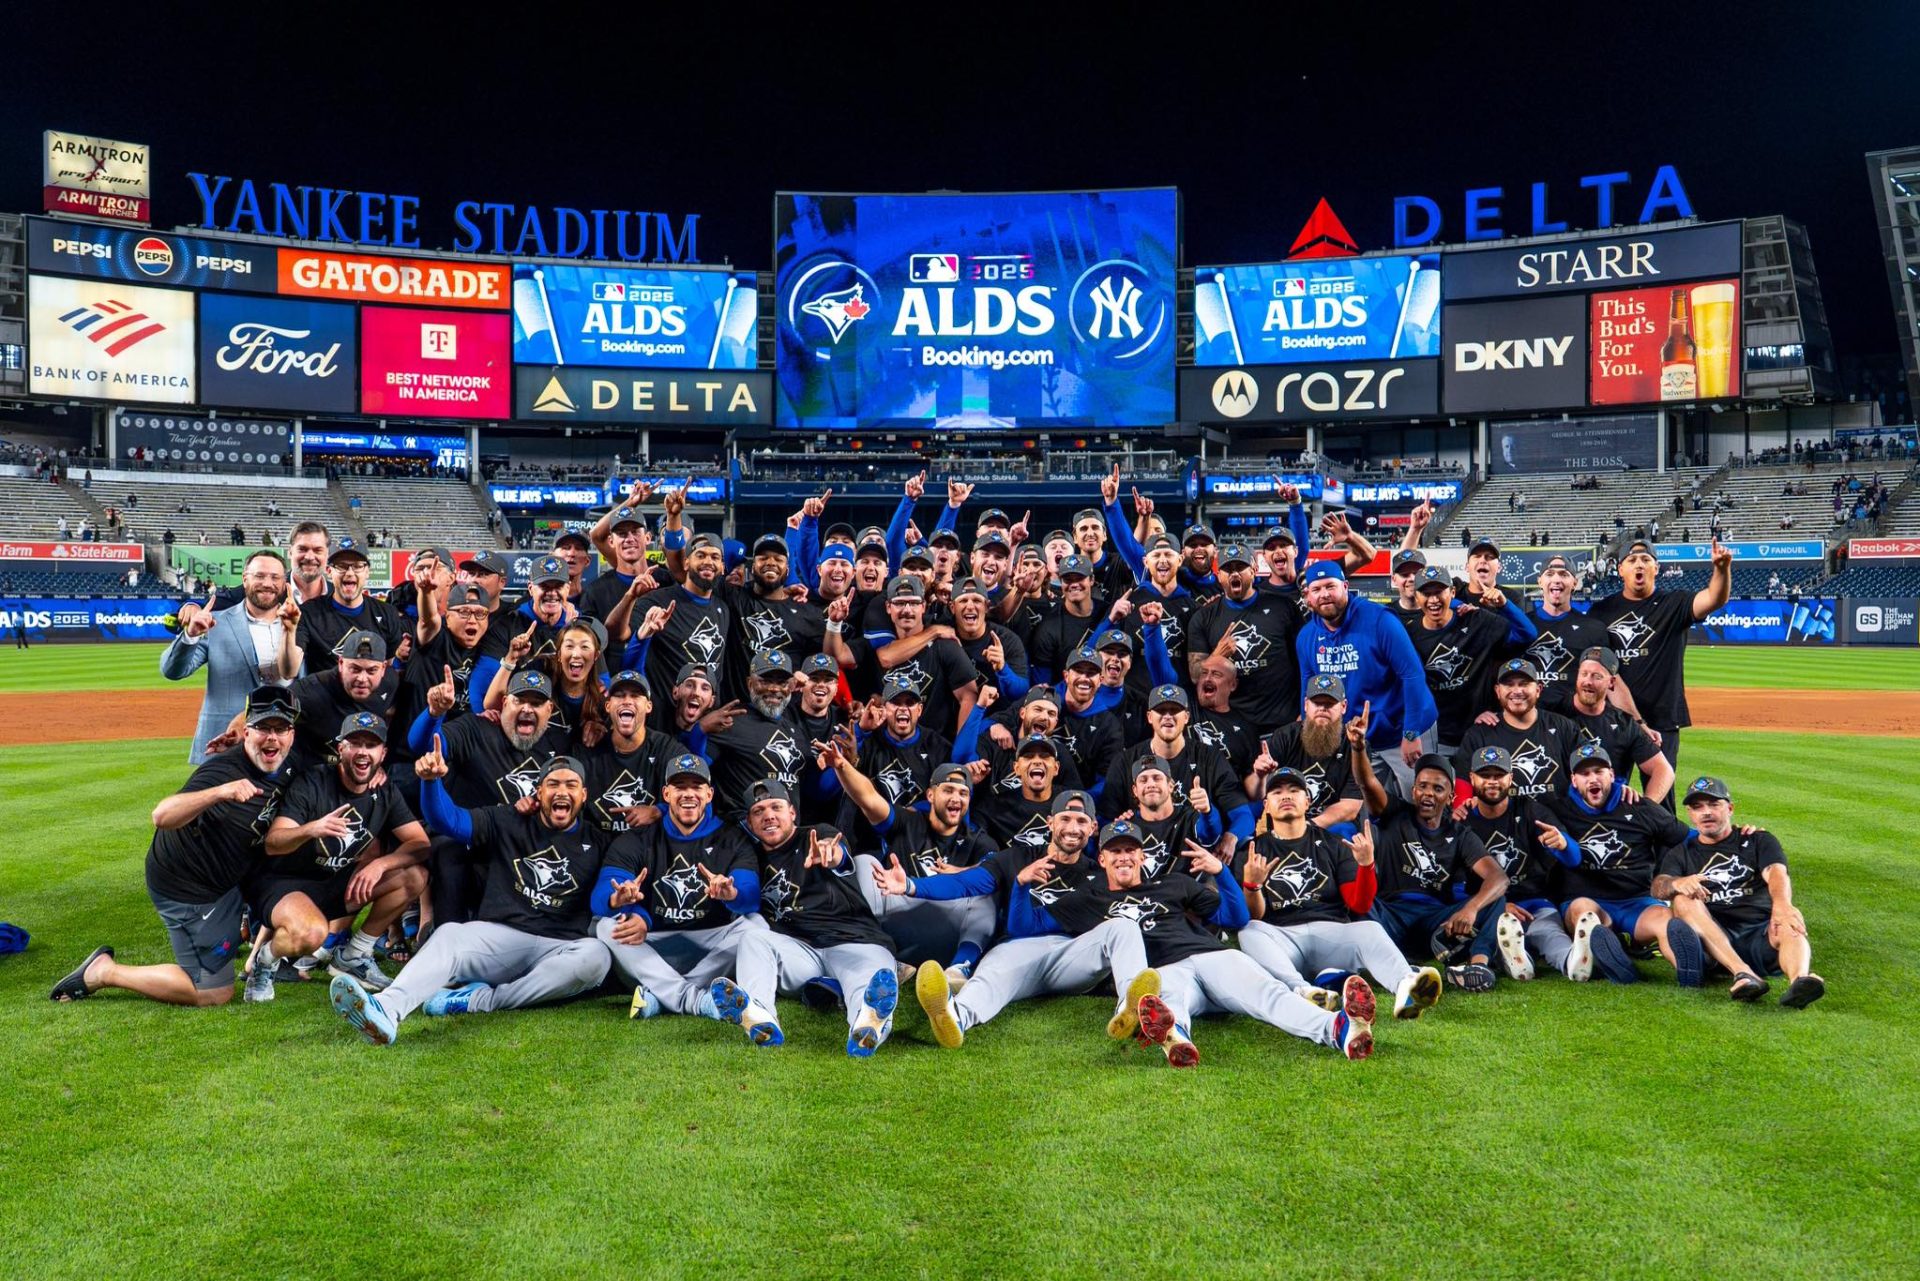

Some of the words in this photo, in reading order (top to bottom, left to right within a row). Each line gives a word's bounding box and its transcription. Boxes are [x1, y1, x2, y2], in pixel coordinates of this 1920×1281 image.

[52, 140, 144, 165] ARMITRON
[57, 190, 140, 211] ARMITRON
[1393, 165, 1698, 249] DELTA
[98, 206, 138, 219] WATCHES
[186, 171, 420, 250] YANKEE
[453, 201, 701, 264] STADIUM
[53, 238, 111, 259] PEPSI
[137, 252, 171, 263] PEPSI
[197, 255, 252, 274] PEPSI
[1517, 241, 1661, 288] STARR
[292, 258, 500, 300] GATORADE
[966, 263, 1035, 280] 2025
[629, 291, 674, 302] 2025
[1309, 282, 1355, 295] 2025
[891, 285, 1057, 336] ALDS
[1262, 295, 1368, 331] ALDS
[1599, 297, 1646, 317] This
[581, 304, 684, 336] ALDS
[1600, 317, 1656, 338] Bud's
[216, 323, 341, 378] Ford
[601, 339, 685, 356] Booking.com
[1281, 334, 1366, 350] Booking.com
[1600, 340, 1634, 358] For
[922, 346, 1054, 370] Booking.com
[1455, 336, 1574, 374] DKNY
[33, 365, 81, 381] BANK
[86, 371, 107, 382] OF
[113, 373, 190, 388] AMERICA
[1599, 360, 1643, 377] You.
[386, 373, 418, 385] BEST
[422, 374, 490, 389] NETWORK
[399, 387, 413, 399] IN
[417, 388, 478, 402] AMERICA
[591, 379, 757, 413] DELTA
[1276, 368, 1405, 413] razr
[1564, 458, 1588, 468] THE
[1592, 456, 1623, 467] BOSS
[553, 490, 598, 504] YANKEES
[563, 520, 599, 529] TERRAC
[1657, 549, 1680, 557] DUEL
[1771, 547, 1808, 555] FANDUEL
[1852, 543, 1900, 554] Reebok
[53, 615, 90, 624] 2025
[1860, 613, 1878, 625] GS
[1234, 660, 1259, 670] ALCS
[1334, 650, 1360, 664] JAYS
[1518, 783, 1547, 797] ALCS
[523, 885, 553, 907] ALCS
[1711, 887, 1744, 903] ALCS
[663, 907, 696, 920] ALCS
